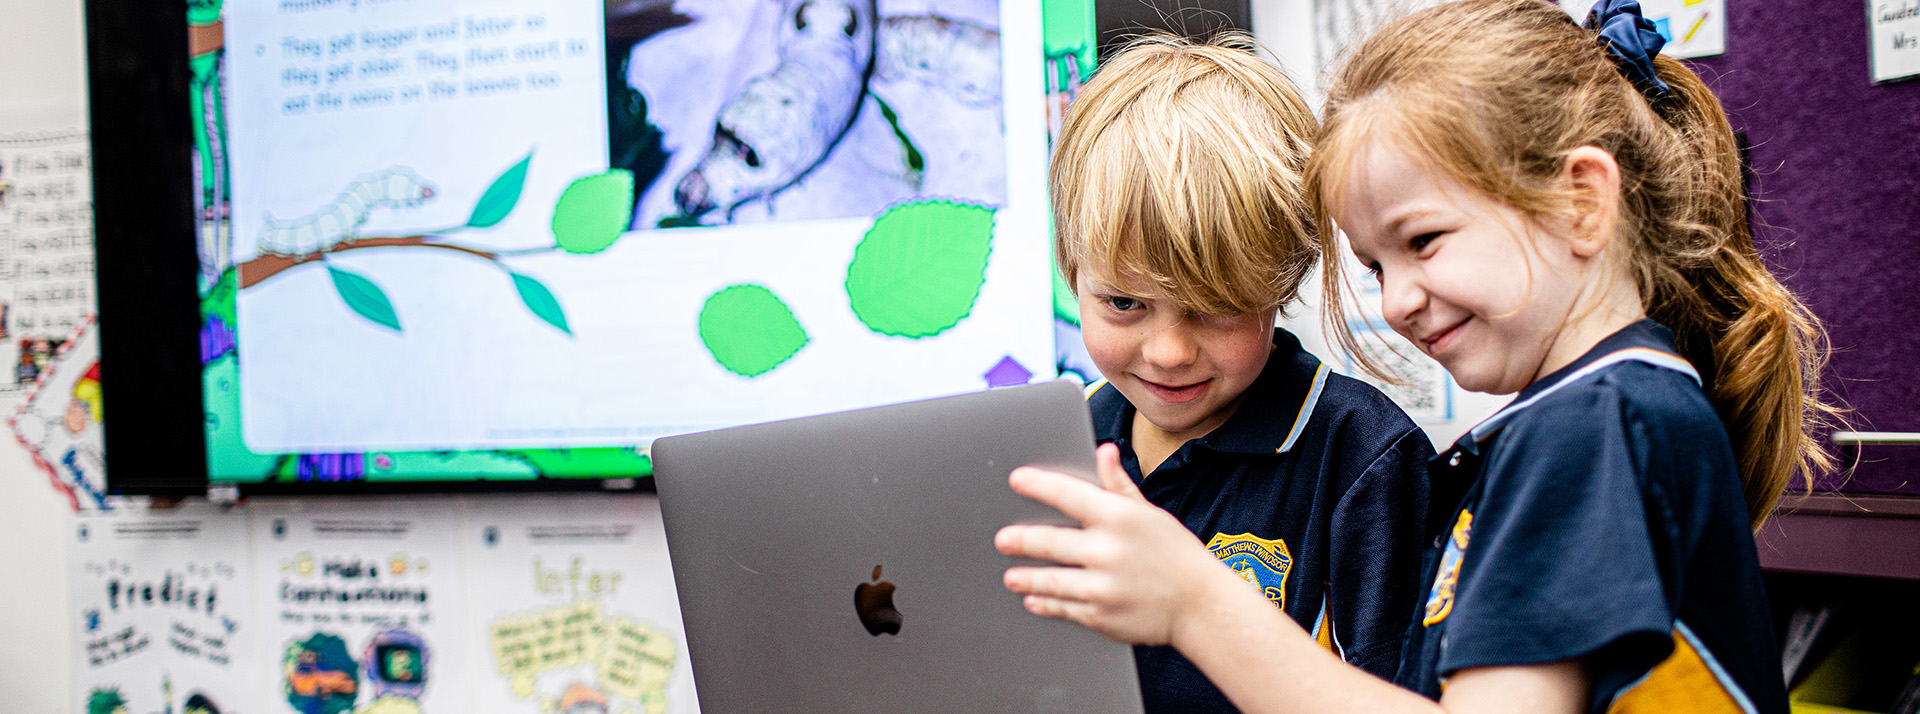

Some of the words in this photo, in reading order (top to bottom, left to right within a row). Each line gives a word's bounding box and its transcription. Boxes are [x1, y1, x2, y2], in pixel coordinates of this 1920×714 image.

[282, 35, 321, 58] They
[327, 33, 355, 56] get
[361, 28, 417, 53] bigger
[423, 21, 458, 41] and
[1893, 33, 1917, 49] Mrs
[281, 67, 319, 88] they
[326, 64, 353, 84] get
[567, 39, 587, 56] to
[315, 92, 342, 110] the
[428, 82, 456, 99] the
[1215, 542, 1257, 559] MATTHEWS
[1254, 547, 1288, 571] WINDSOR
[108, 571, 216, 616] Predict
[533, 557, 621, 598] Infer
